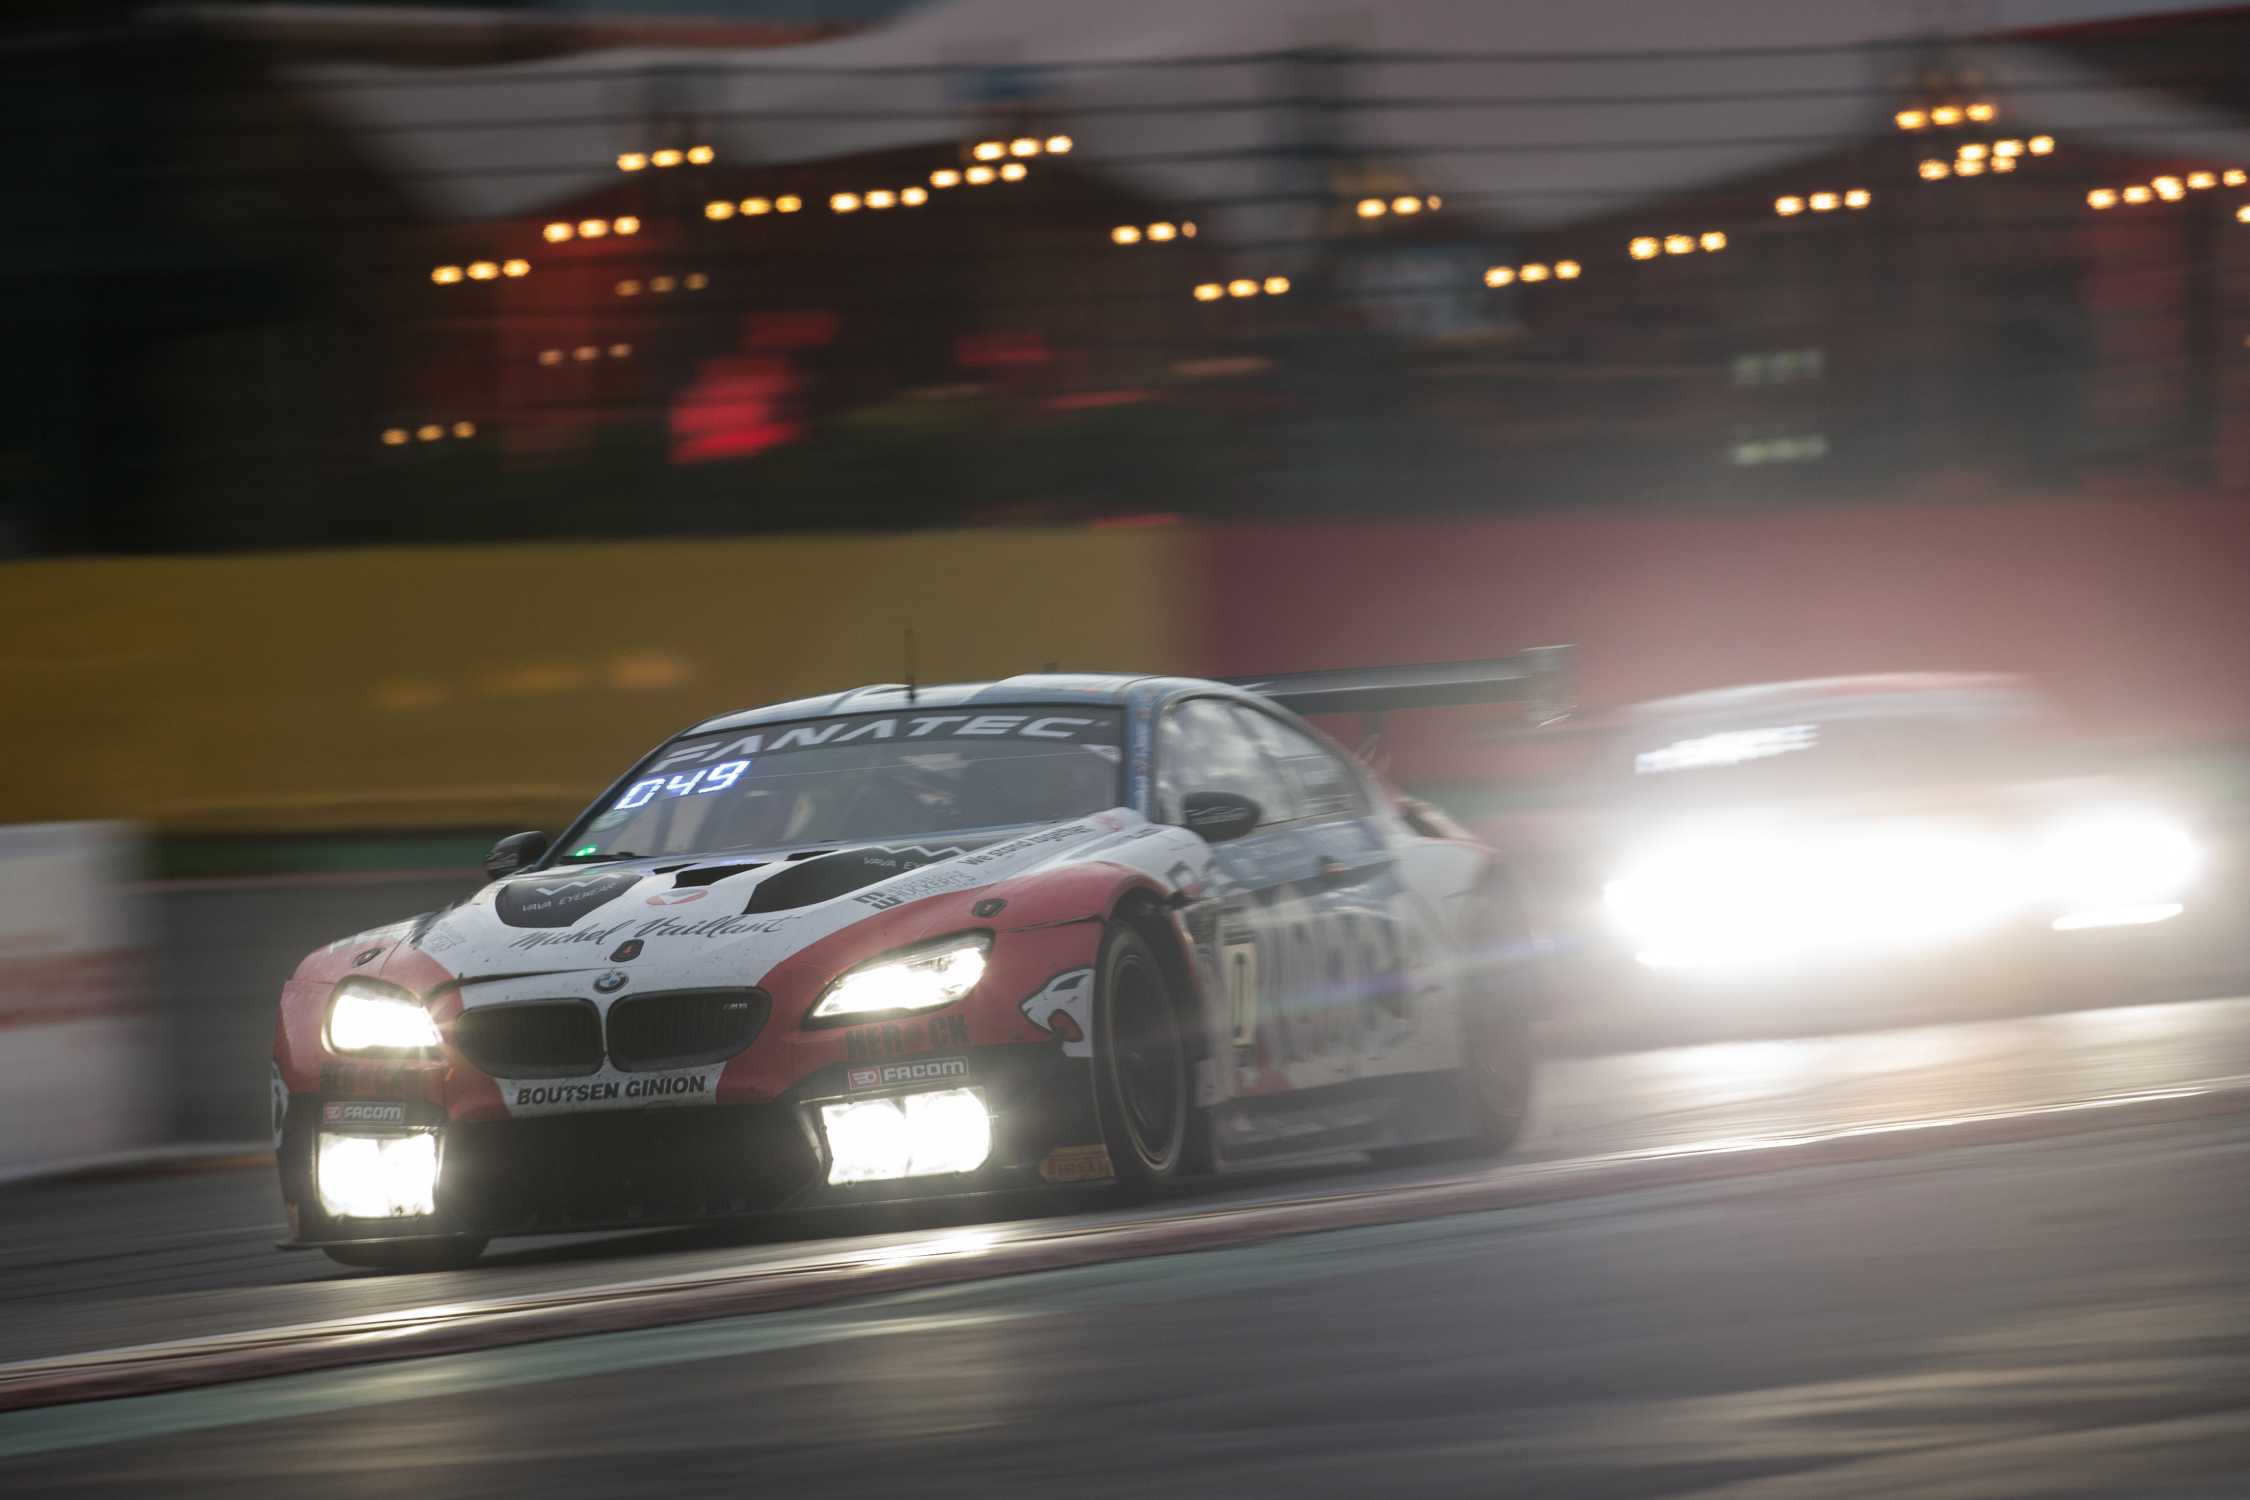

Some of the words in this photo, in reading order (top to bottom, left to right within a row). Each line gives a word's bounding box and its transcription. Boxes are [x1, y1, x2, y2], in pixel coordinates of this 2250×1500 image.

[648, 715, 1094, 773] FANATEC
[613, 760, 752, 810] 049
[508, 919, 636, 950] Michel
[634, 915, 803, 938] Vaillant
[517, 1082, 620, 1105] BOUTSEN
[624, 1075, 706, 1097] GINION
